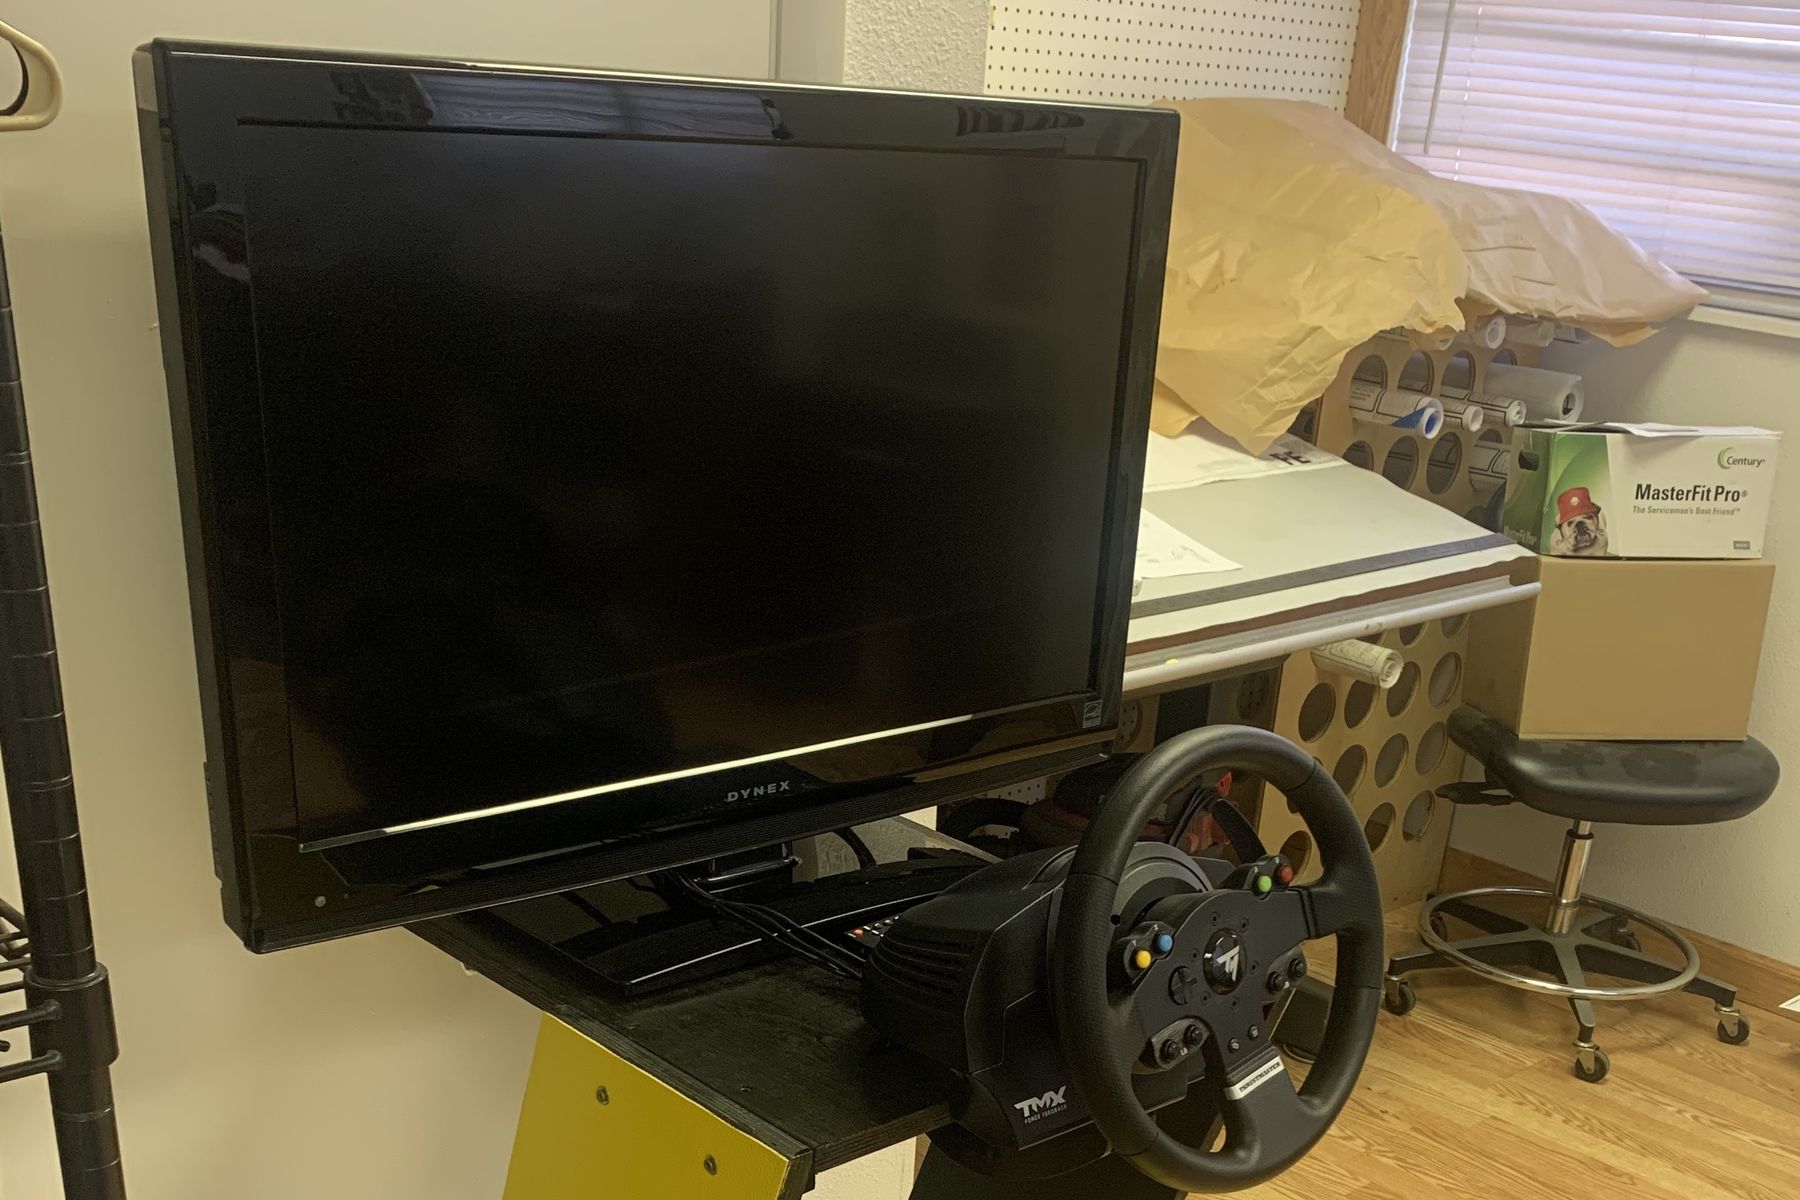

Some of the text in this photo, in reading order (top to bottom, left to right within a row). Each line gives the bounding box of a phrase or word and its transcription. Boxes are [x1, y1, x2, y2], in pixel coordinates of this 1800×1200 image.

[1634, 483, 1711, 502] MasterFit
[1632, 505, 1646, 515] The
[1647, 506, 1694, 516] Serviceman's
[1695, 507, 1711, 516] Best
[727, 780, 791, 802] DYNEX
[1013, 1085, 1067, 1118] TMX
